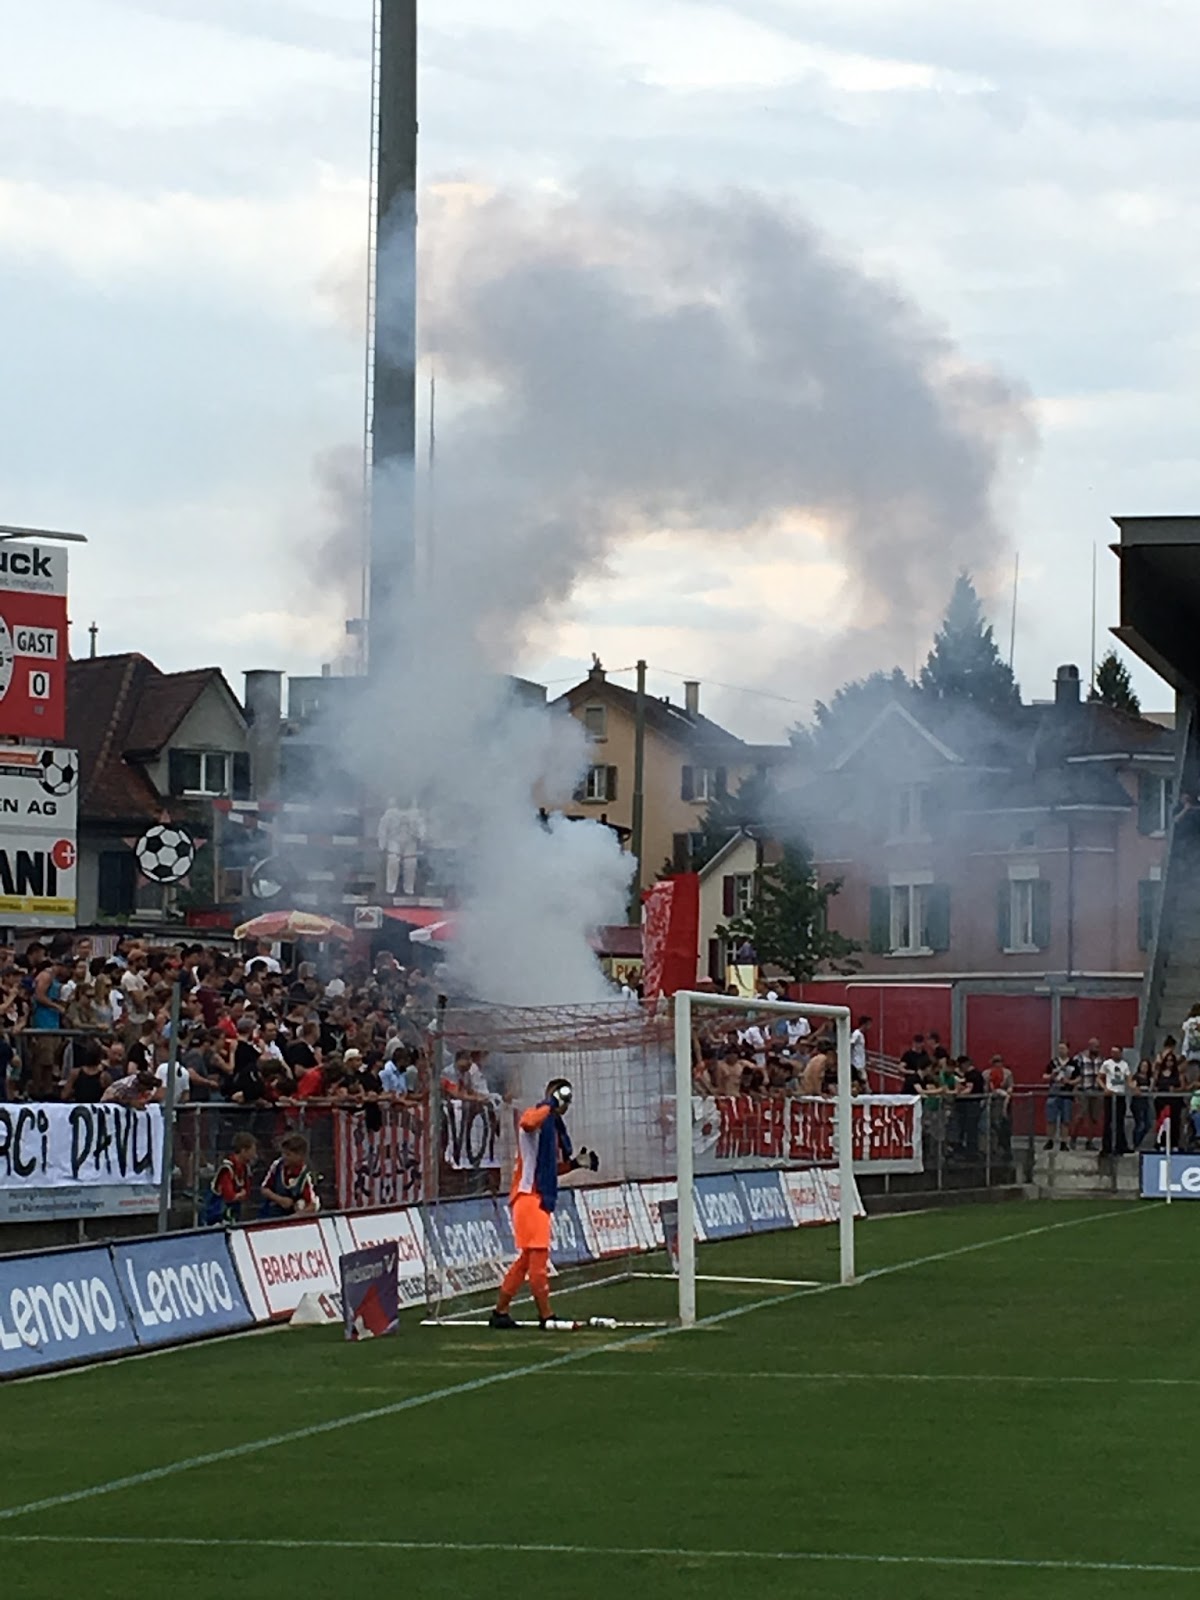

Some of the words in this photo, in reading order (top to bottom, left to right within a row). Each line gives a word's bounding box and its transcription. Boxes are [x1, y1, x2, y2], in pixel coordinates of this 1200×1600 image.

[17, 631, 54, 654] GAST
[32, 673, 46, 696] 0
[0, 798, 18, 813] N
[27, 800, 57, 816] AG
[261, 1249, 329, 1286] BRACK.CH
[126, 1258, 234, 1327] Lenovo
